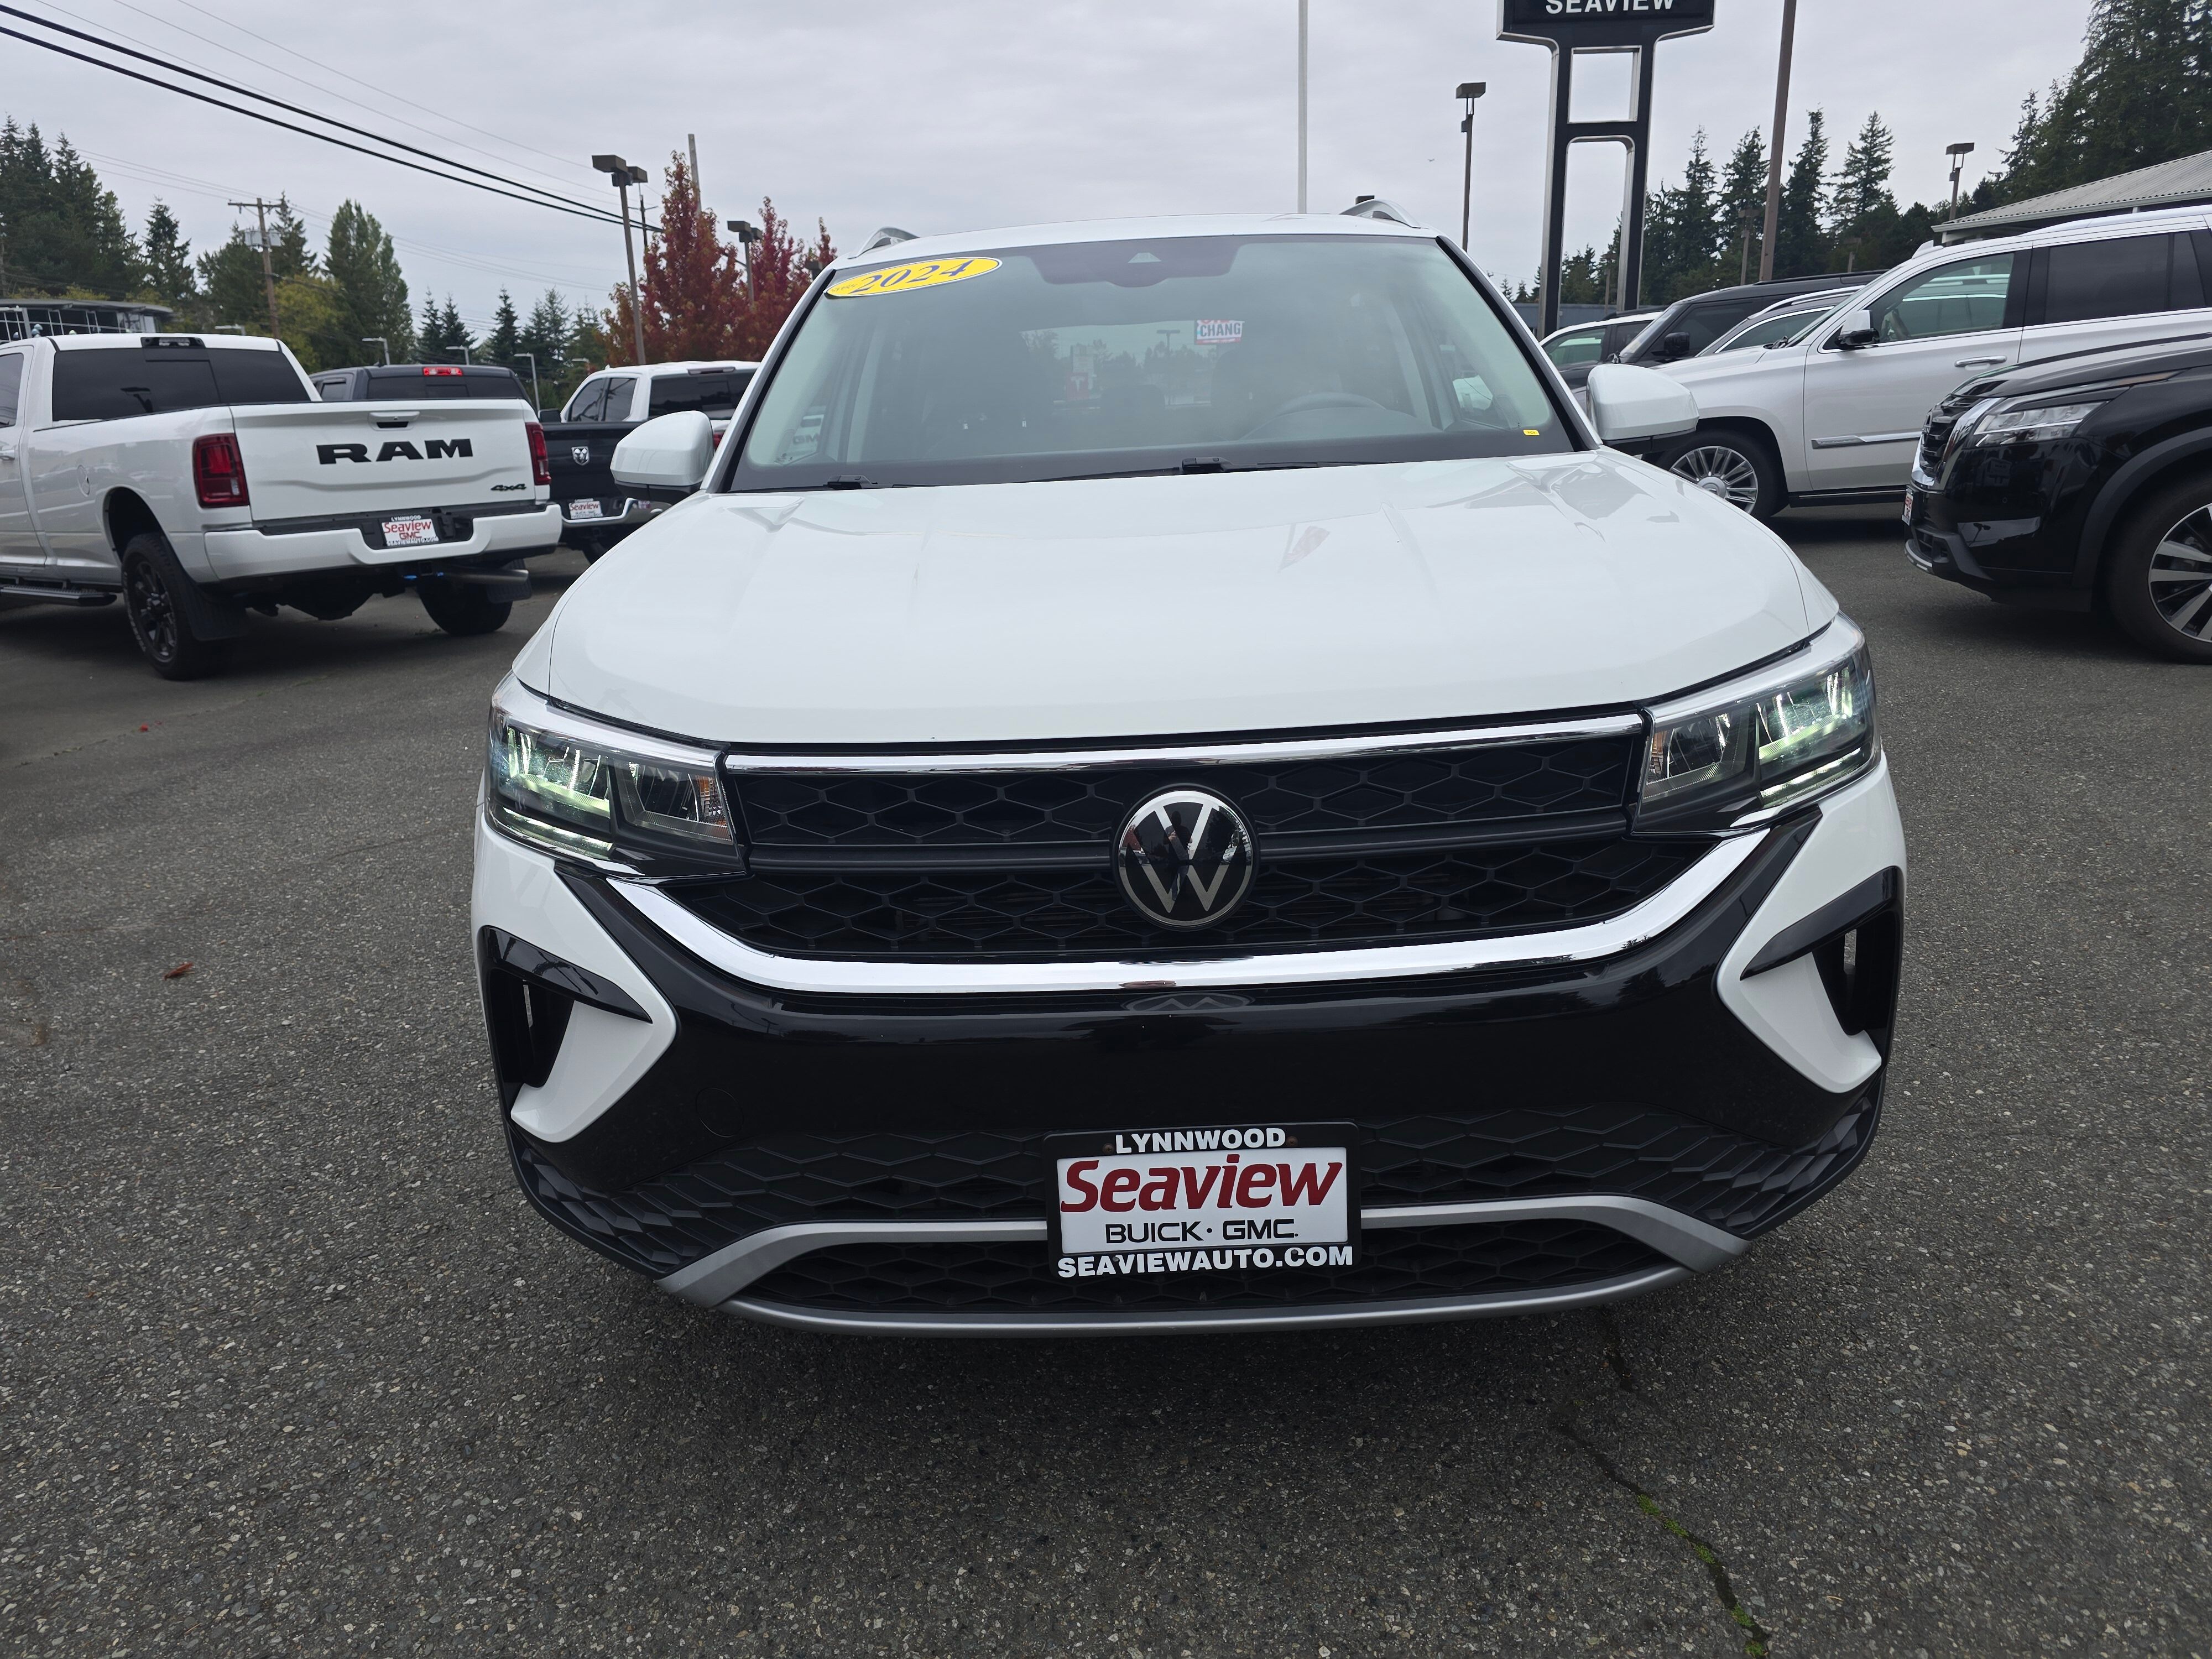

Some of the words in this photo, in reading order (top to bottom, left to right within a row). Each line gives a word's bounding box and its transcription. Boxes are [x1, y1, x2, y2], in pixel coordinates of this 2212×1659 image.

[1546, 0, 1673, 14] SEAVIEW
[847, 258, 975, 294] 2024
[1200, 322, 1241, 337] CHANG
[316, 439, 473, 465] RAM
[384, 520, 431, 534] Seaview
[399, 531, 422, 540] GMC
[1115, 1128, 1286, 1154] LYNNWOOD
[1060, 1154, 1343, 1213] Seaview
[1105, 1220, 1204, 1244] BUICK
[1057, 1246, 1353, 1278] SEAVIEWAUTO.COM
